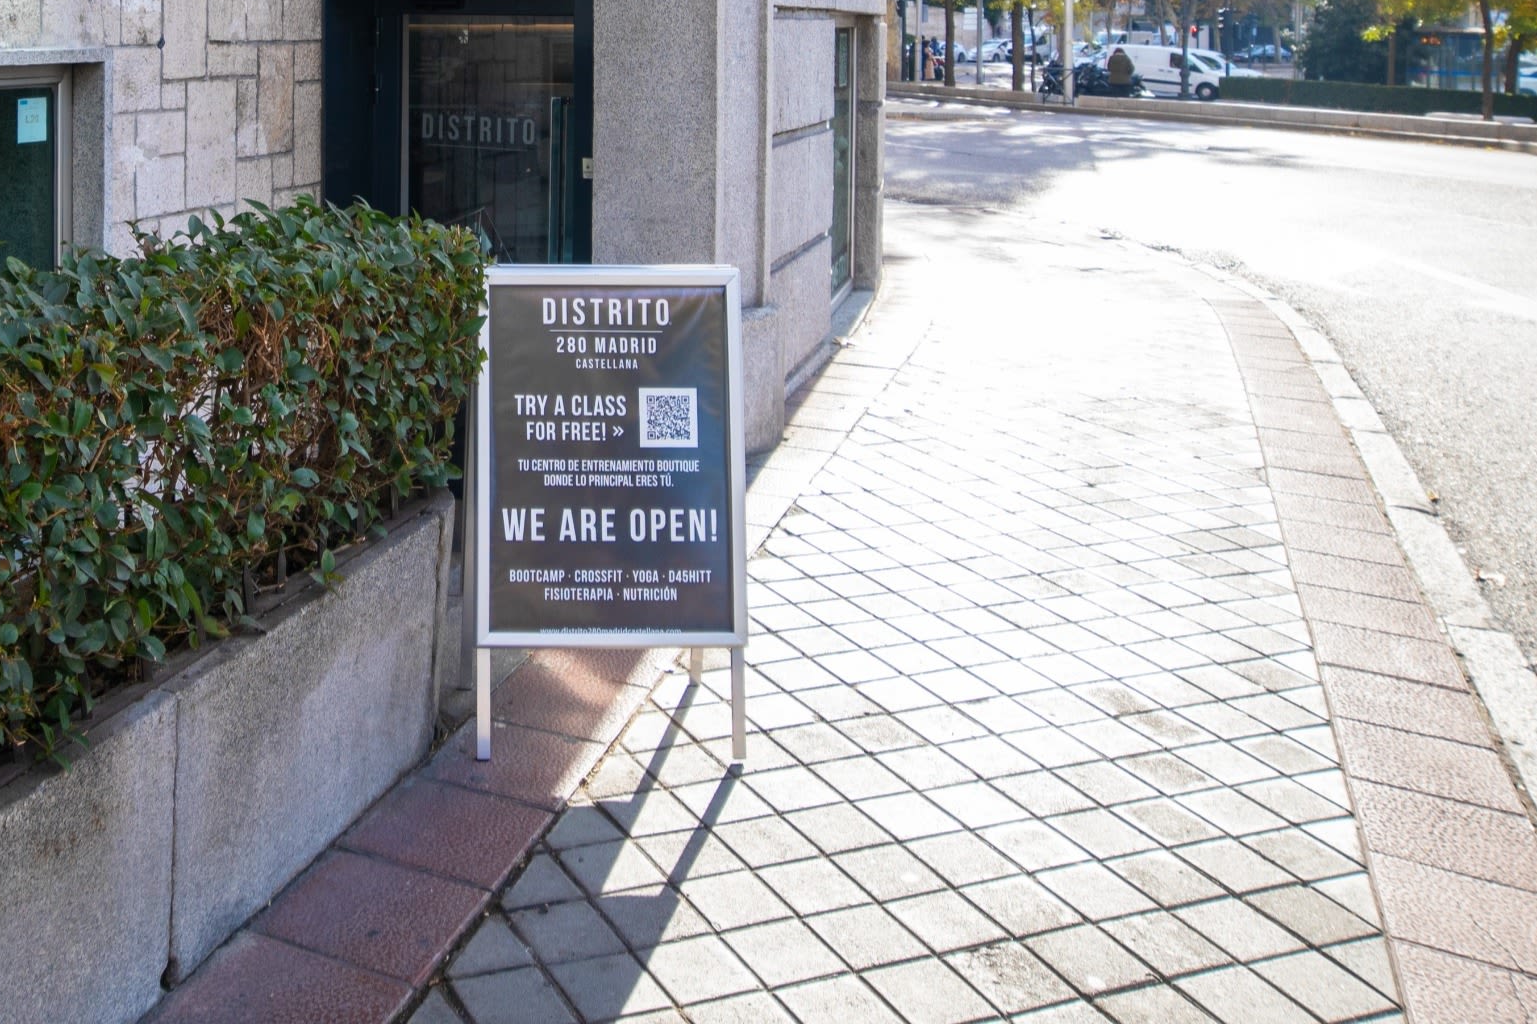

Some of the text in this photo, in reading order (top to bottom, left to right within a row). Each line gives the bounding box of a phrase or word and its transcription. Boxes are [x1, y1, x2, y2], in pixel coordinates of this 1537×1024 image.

[422, 112, 535, 145] DISTRITO
[542, 297, 670, 326] DISTRITO
[556, 336, 657, 354] 280 MADRID
[575, 358, 638, 370] CASTELLANA
[514, 394, 627, 417] TRY A CLASS
[526, 421, 606, 441] FOR FREE!
[518, 459, 700, 472] TU CENTRO DE ENTRENAMIENTO BOUTIQUE
[544, 473, 674, 487] DONDE LO PRINCIPAL ERES TÚ.
[502, 507, 718, 542] WE ARE OPEN!
[509, 569, 712, 583] BOOTCAMP CROSSFIT YOGA D45HITT
[544, 586, 678, 601] FISIOTERAPIA NUTRICIÓN
